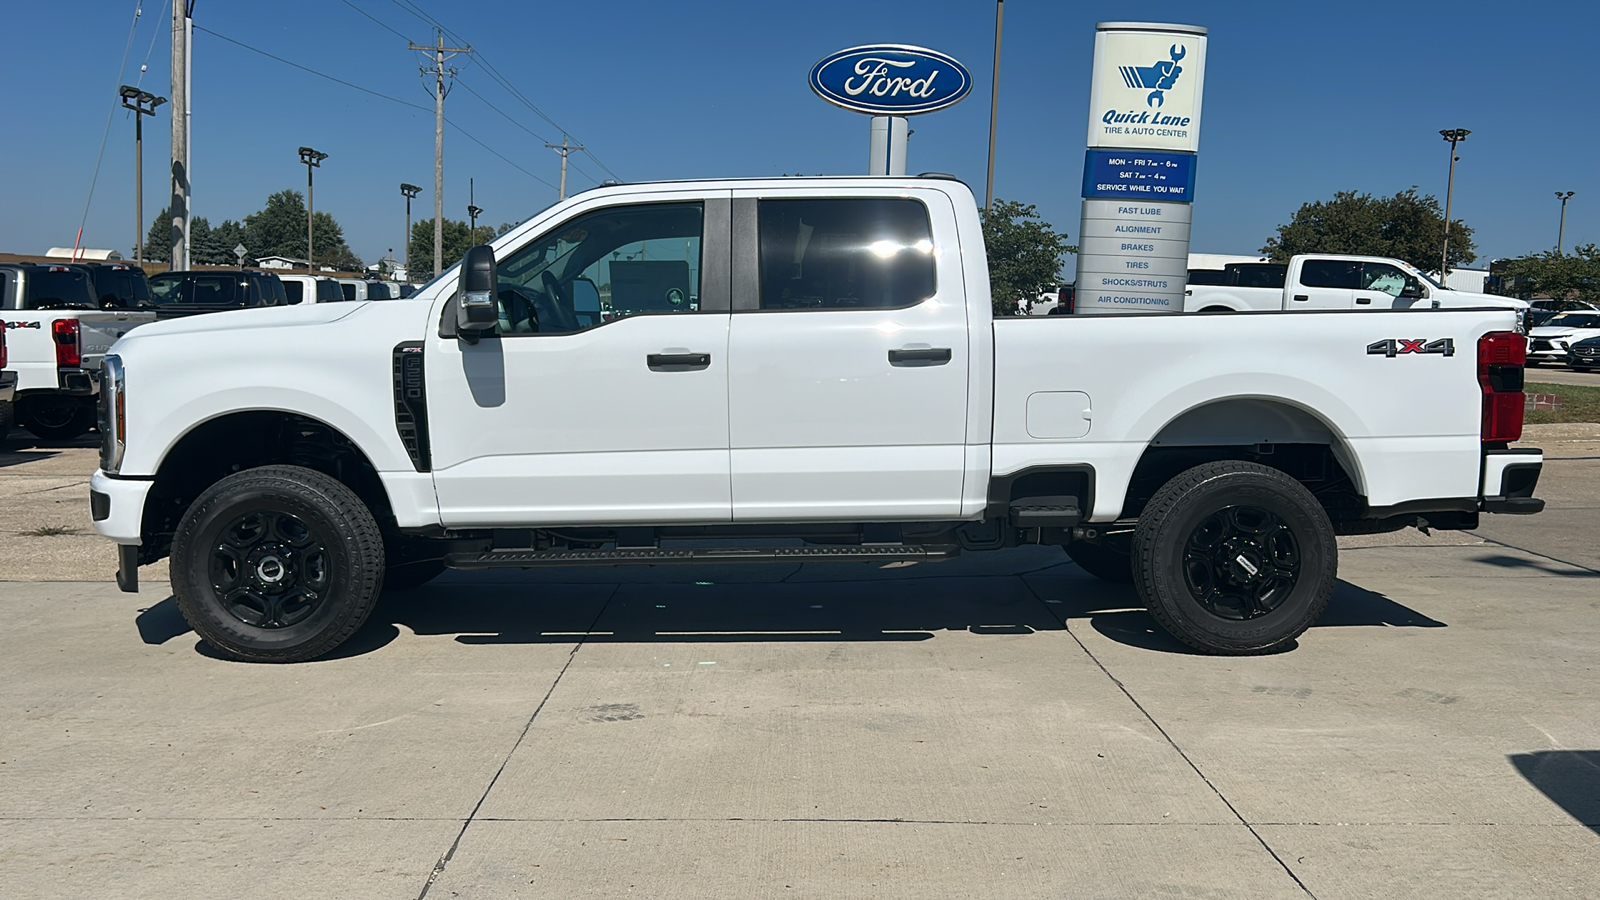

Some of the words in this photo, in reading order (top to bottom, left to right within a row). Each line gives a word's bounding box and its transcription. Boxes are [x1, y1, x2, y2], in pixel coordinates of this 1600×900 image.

[845, 58, 938, 98] Ford
[1102, 110, 1150, 124] Quick
[1151, 112, 1190, 126] Lane
[1156, 129, 1187, 137] CENTER
[1115, 226, 1161, 234] ALIGNMENT
[1102, 278, 1167, 288] SHOCKS/STRUTS
[1114, 297, 1169, 306] CONDITIONING
